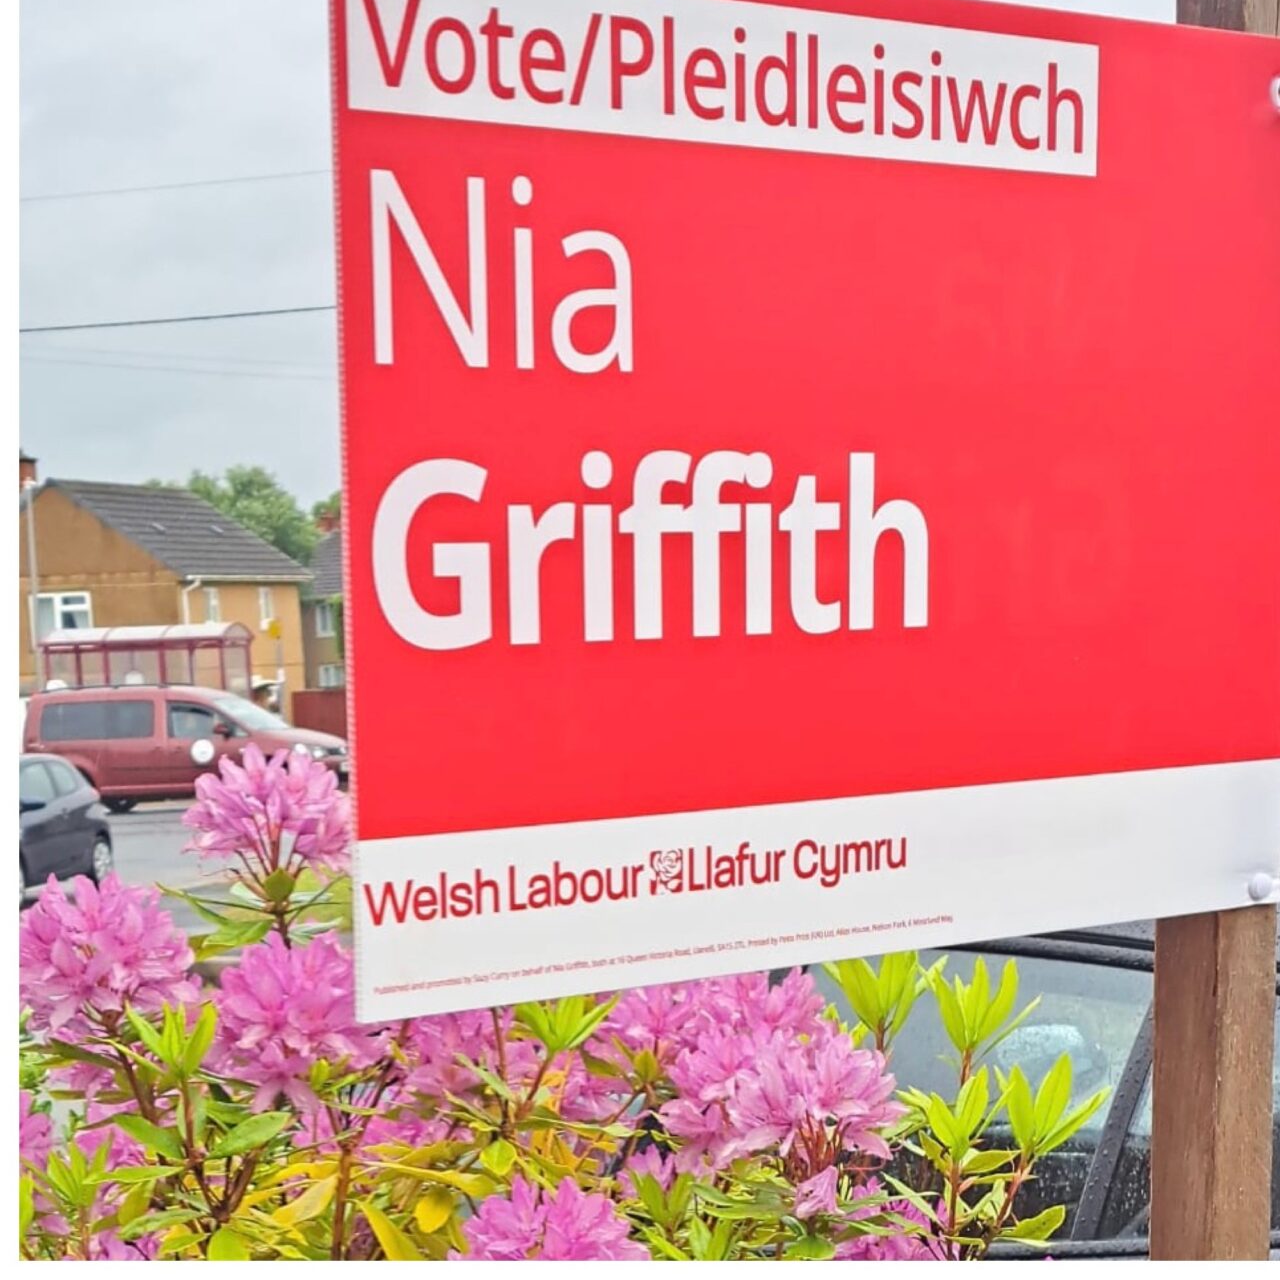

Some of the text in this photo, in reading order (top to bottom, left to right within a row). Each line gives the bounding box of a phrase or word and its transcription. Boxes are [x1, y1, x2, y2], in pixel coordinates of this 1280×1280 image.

[370, 167, 636, 375] Nia
[369, 449, 930, 653] Griffith
[363, 832, 908, 927] Welsh Labour Llafur Cymru
